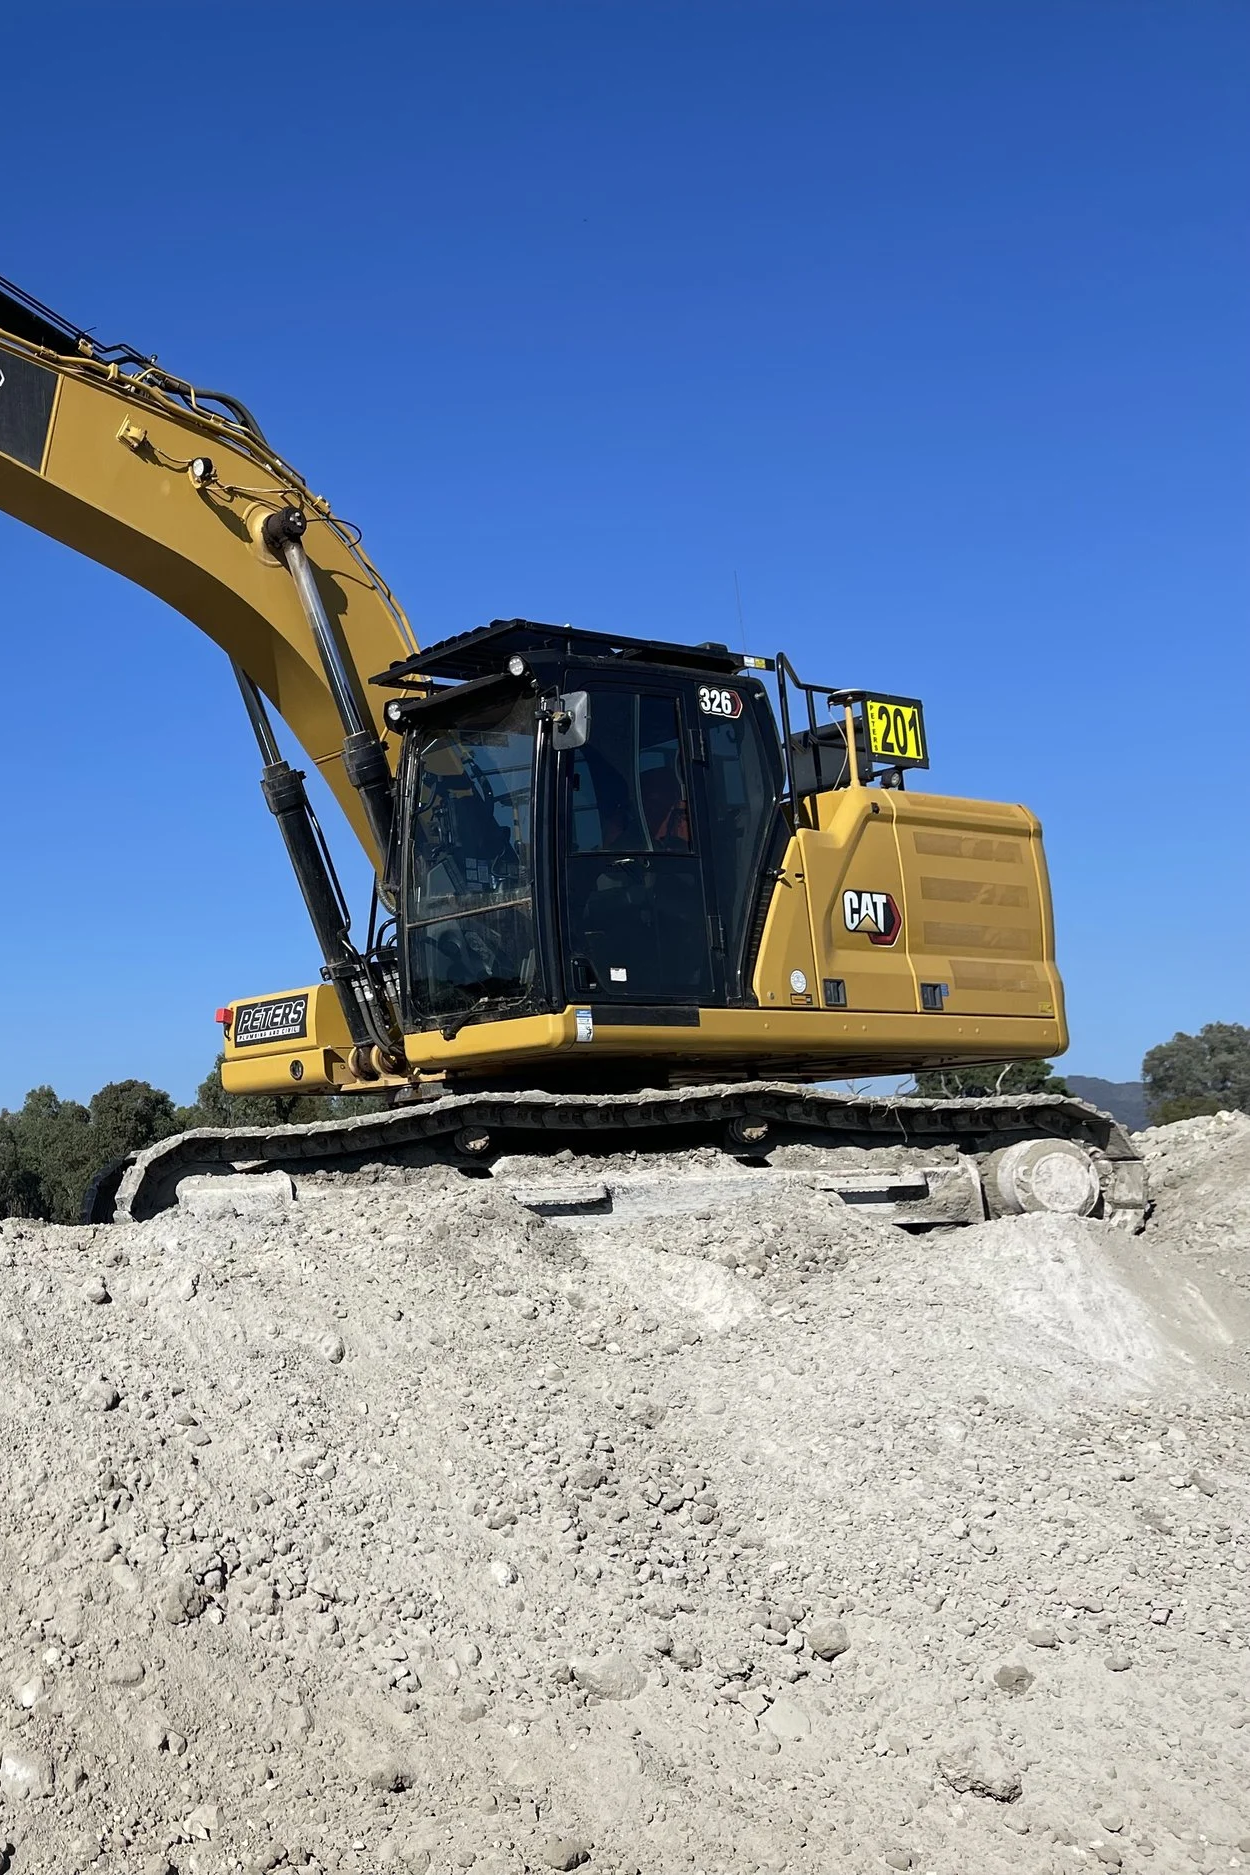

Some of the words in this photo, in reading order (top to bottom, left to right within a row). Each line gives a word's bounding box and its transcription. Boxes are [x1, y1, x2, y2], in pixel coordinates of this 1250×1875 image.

[699, 687, 732, 714] 326
[869, 704, 879, 752] PETERS
[878, 705, 922, 757] 201
[843, 890, 887, 934] CAT
[238, 1000, 306, 1034] PETERS
[239, 1031, 267, 1041] PLUMBING
